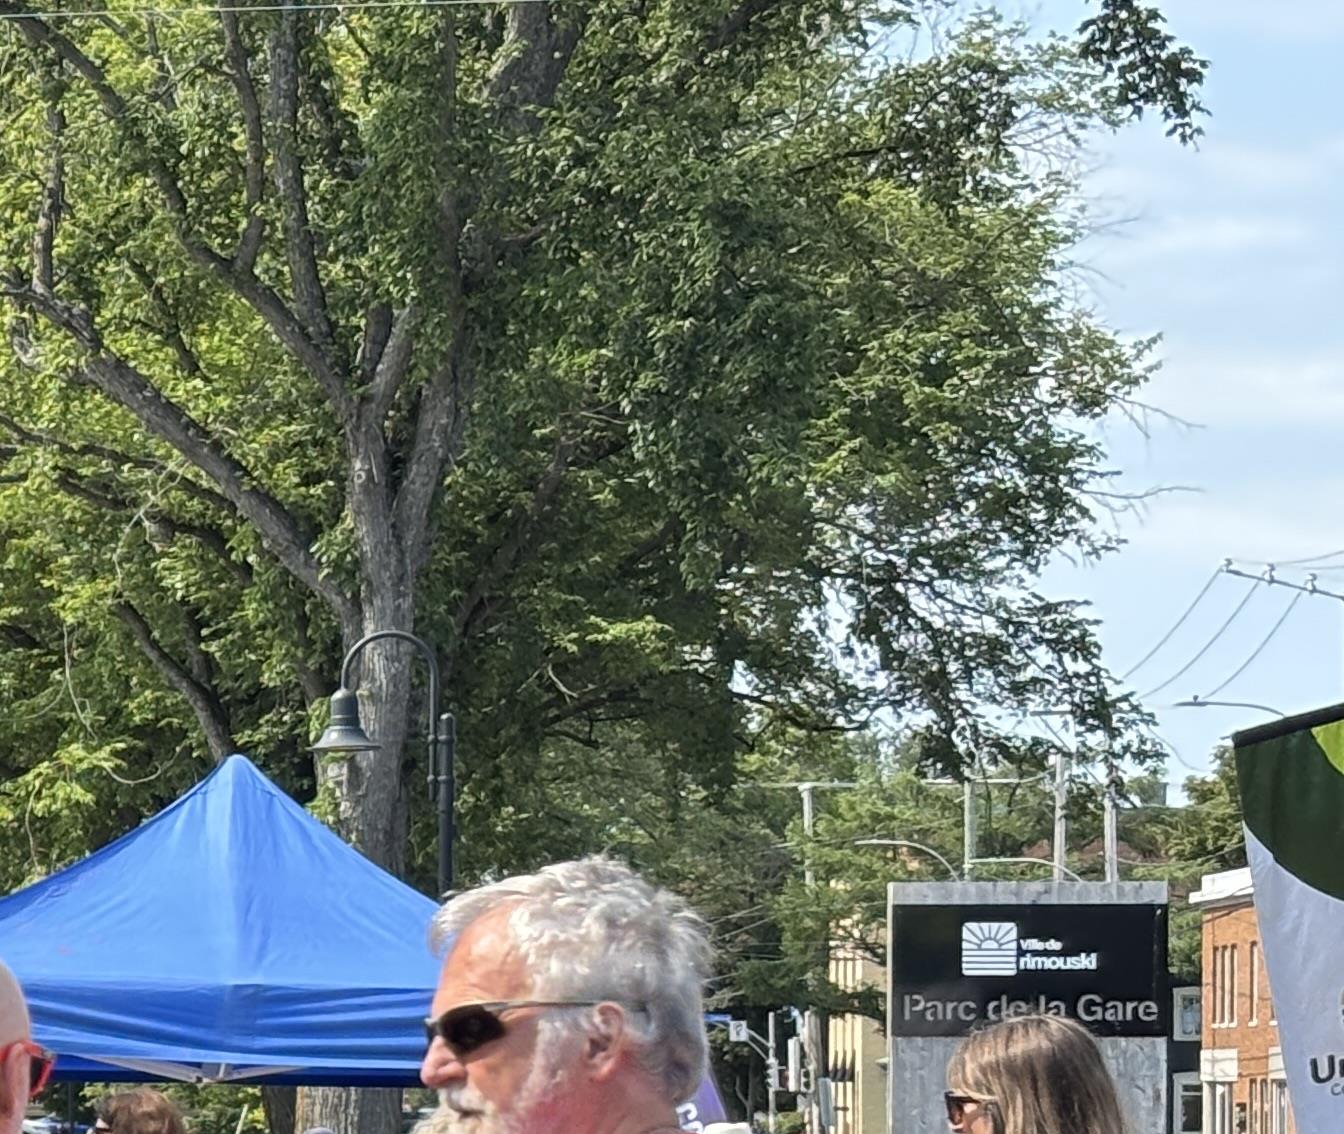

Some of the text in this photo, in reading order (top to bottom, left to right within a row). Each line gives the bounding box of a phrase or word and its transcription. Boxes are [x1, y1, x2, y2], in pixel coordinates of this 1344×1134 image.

[1019, 953, 1098, 970] rimouski
[903, 994, 1159, 1022] Parc de la Gare
